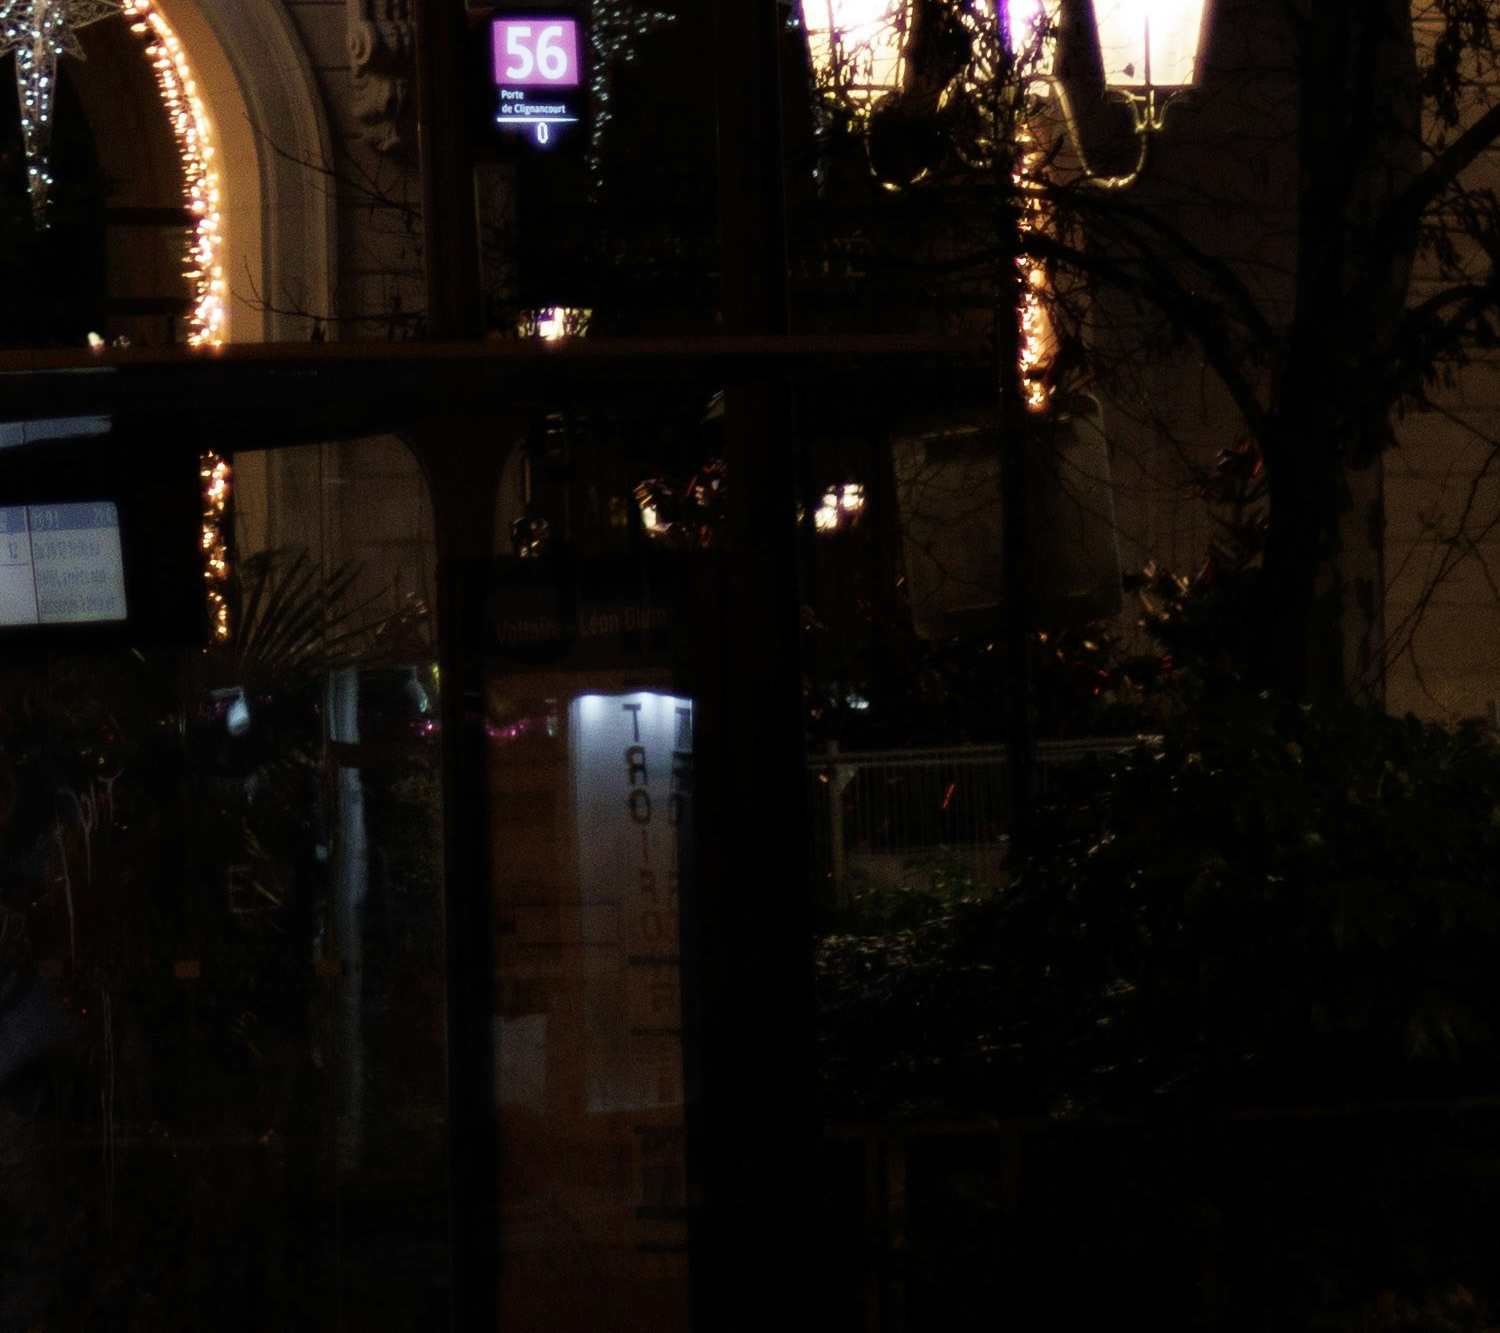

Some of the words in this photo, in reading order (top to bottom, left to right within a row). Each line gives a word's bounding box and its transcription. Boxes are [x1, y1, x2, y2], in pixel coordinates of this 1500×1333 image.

[506, 25, 568, 80] 56
[501, 89, 524, 100] Porte
[501, 103, 513, 114] de
[514, 103, 566, 116] Clignancourt
[537, 121, 549, 144] 0
